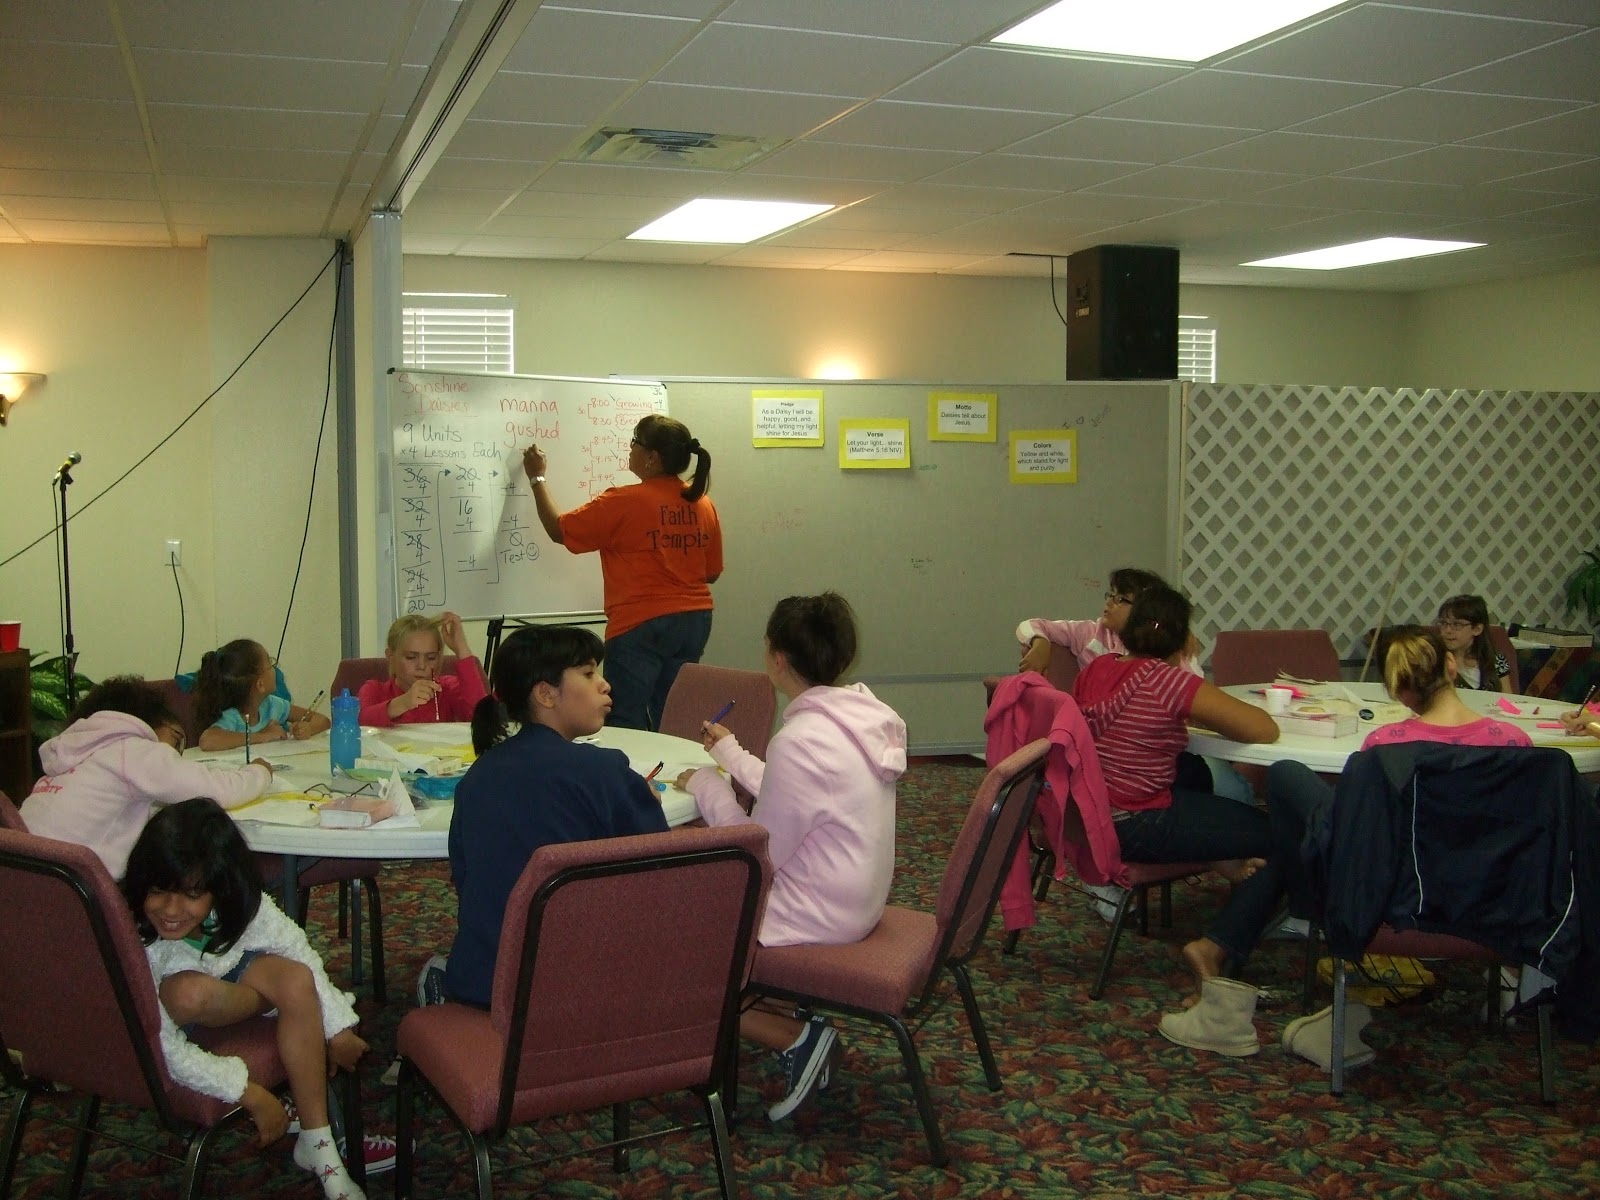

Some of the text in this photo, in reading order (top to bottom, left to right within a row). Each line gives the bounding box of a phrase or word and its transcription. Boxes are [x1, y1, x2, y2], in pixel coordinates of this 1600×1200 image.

[398, 373, 470, 394] Sonshine
[500, 398, 559, 415] manna
[615, 398, 653, 409] Growing
[402, 422, 463, 443] 9 Units
[503, 419, 561, 448] gushed
[805, 423, 818, 431] light
[424, 445, 467, 459] Lessons
[472, 441, 502, 461] Each
[1056, 457, 1069, 465] light
[458, 499, 473, 515] 16
[659, 504, 698, 526] Faith
[646, 527, 709, 555] Temple
[499, 548, 525, 564] Test
[407, 599, 426, 613] 20
